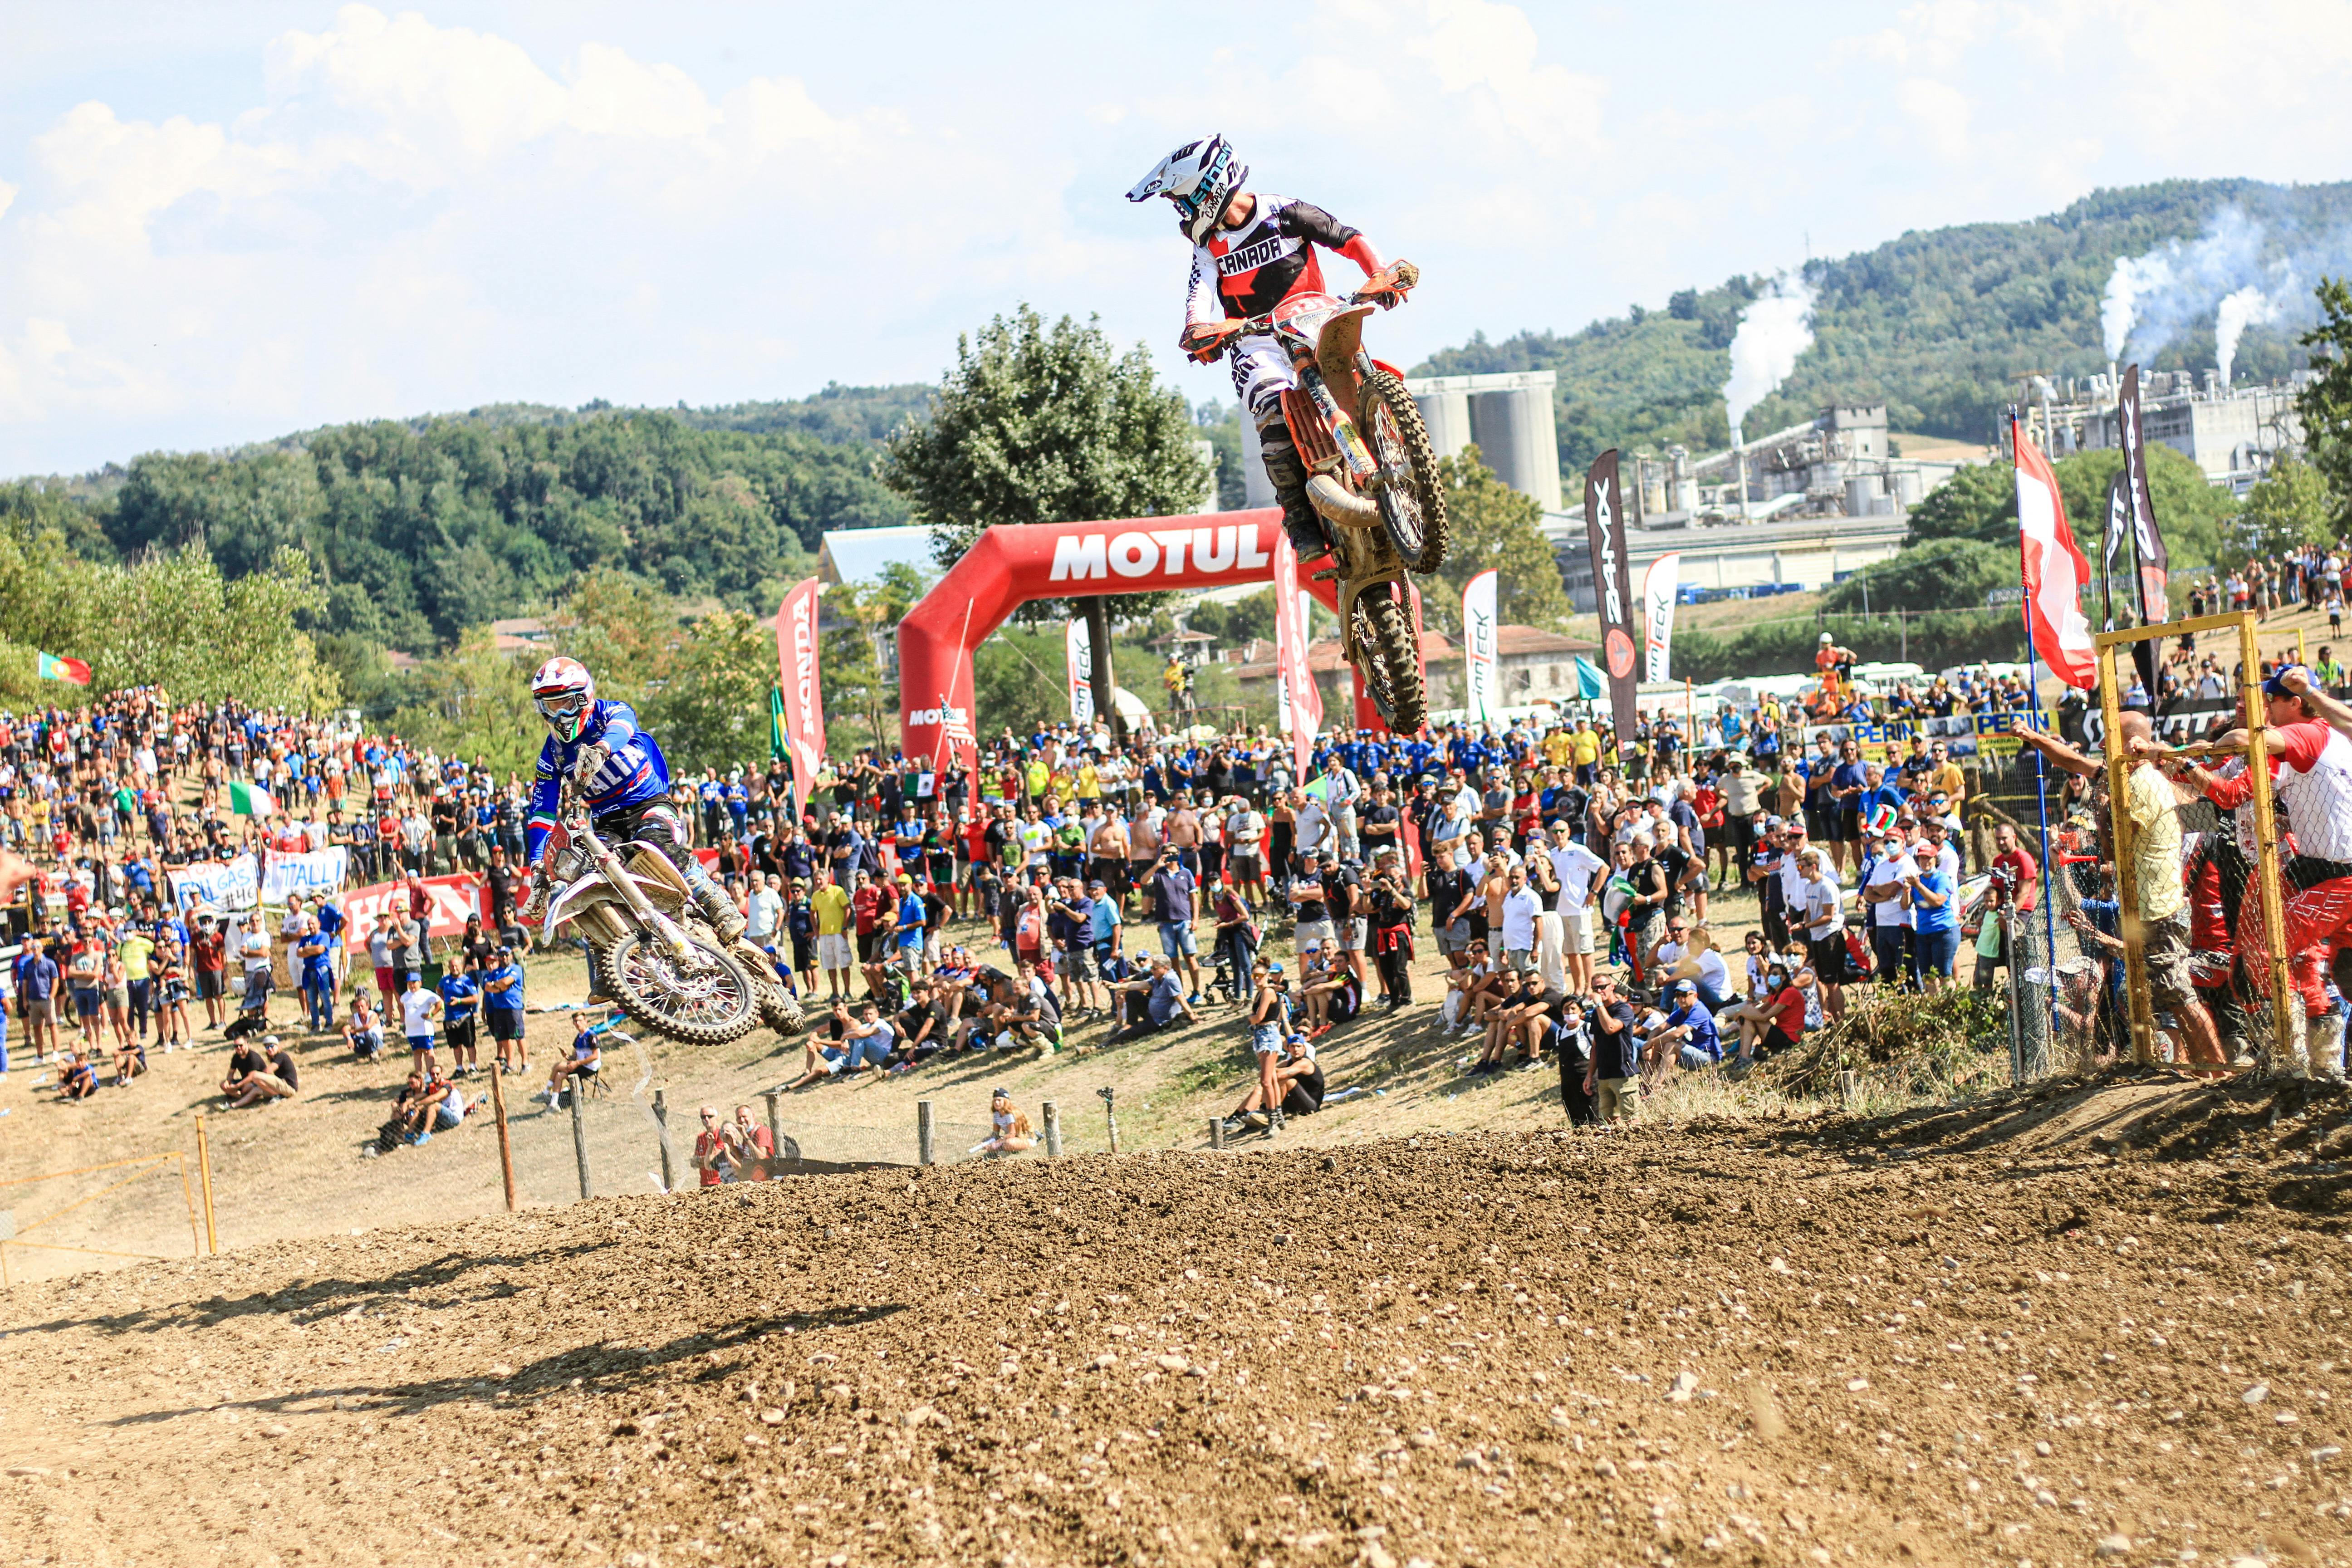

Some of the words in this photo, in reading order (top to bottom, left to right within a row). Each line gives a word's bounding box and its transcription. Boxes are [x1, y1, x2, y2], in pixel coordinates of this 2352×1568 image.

[1204, 182, 1227, 219] CANADA
[1216, 237, 1282, 275] CANADA
[1049, 524, 1270, 582] MOTUL
[1593, 477, 1623, 625] 24MX
[793, 592, 815, 736] HONDA
[909, 708, 968, 726] MOTL
[1854, 722, 1915, 743] PERIN
[583, 744, 646, 797] ALIA
[218, 868, 250, 890] GAS
